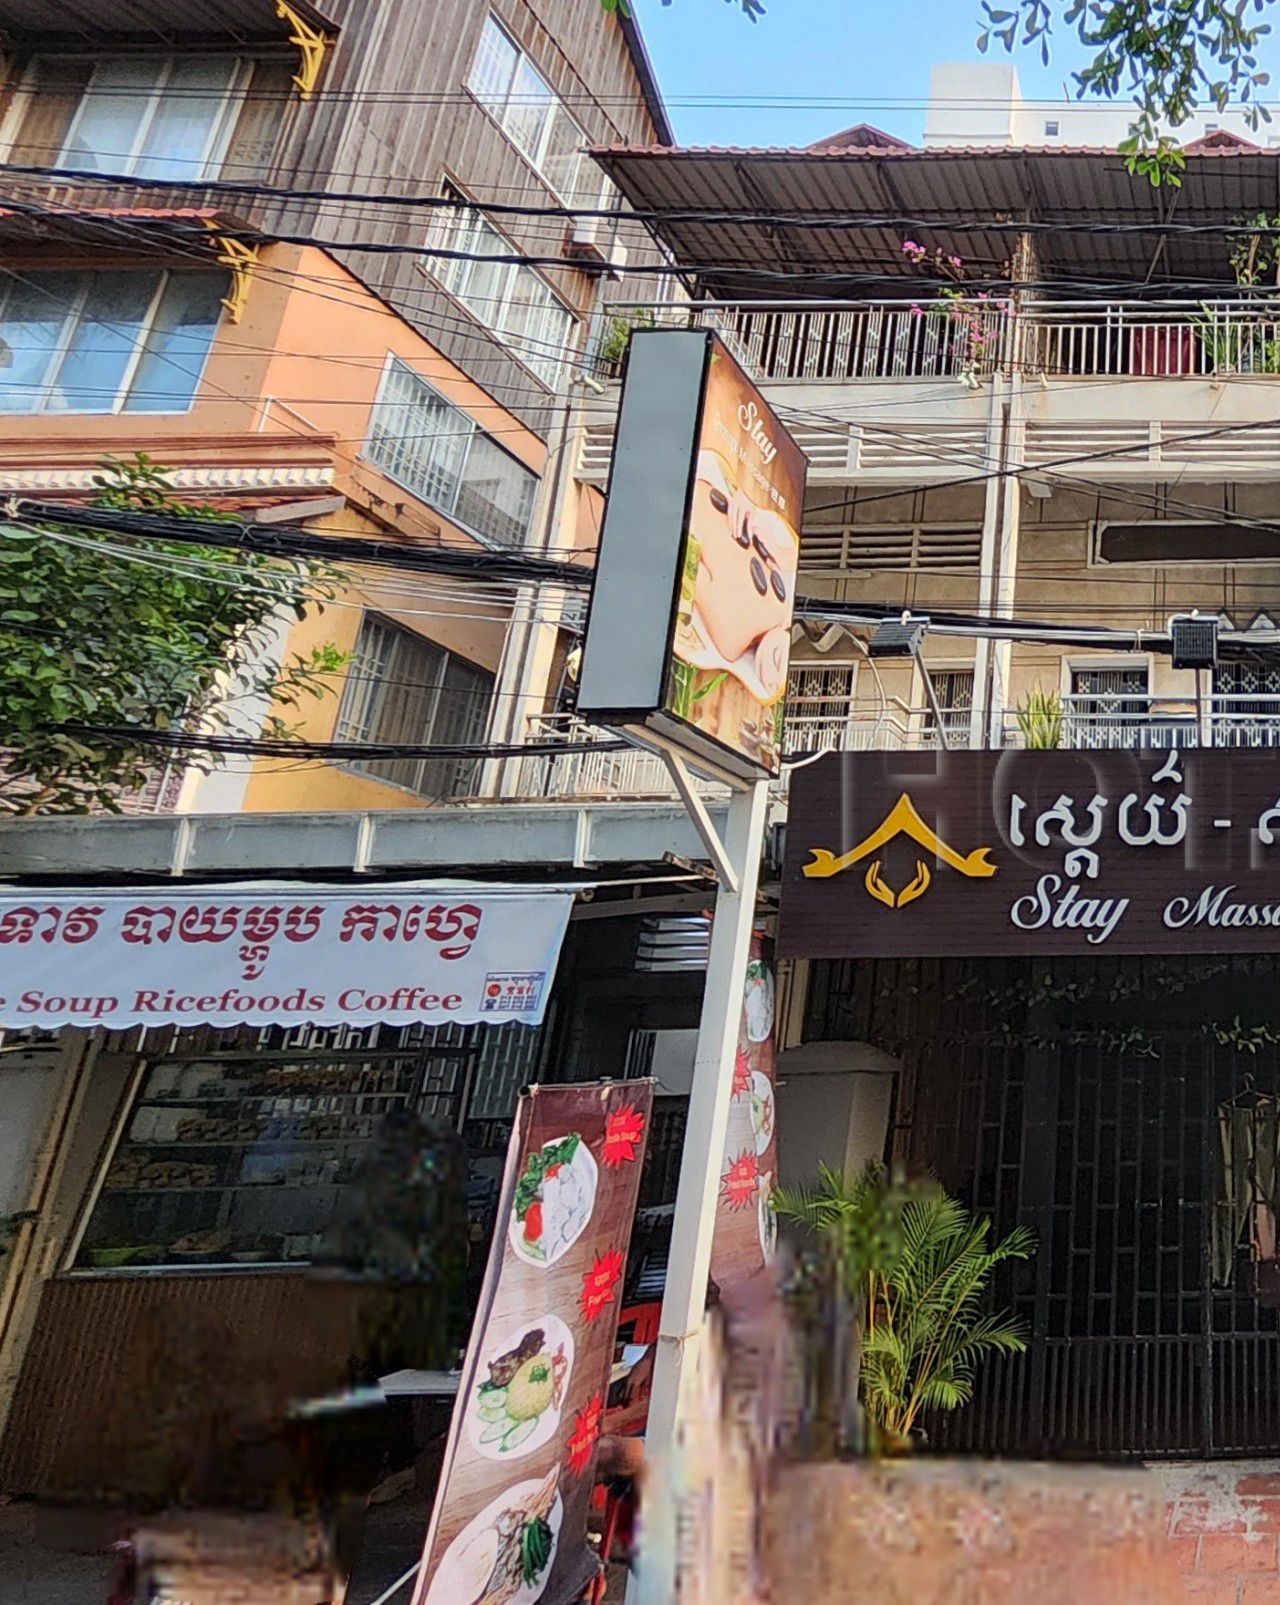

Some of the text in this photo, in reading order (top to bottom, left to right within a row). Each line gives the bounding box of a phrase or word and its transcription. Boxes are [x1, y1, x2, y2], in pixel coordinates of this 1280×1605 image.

[738, 401, 778, 465] Stay
[1010, 874, 1130, 944] Stay
[16, 990, 119, 1019] Soup
[129, 988, 326, 1013] Ricefoods
[337, 987, 463, 1012] Coffee
